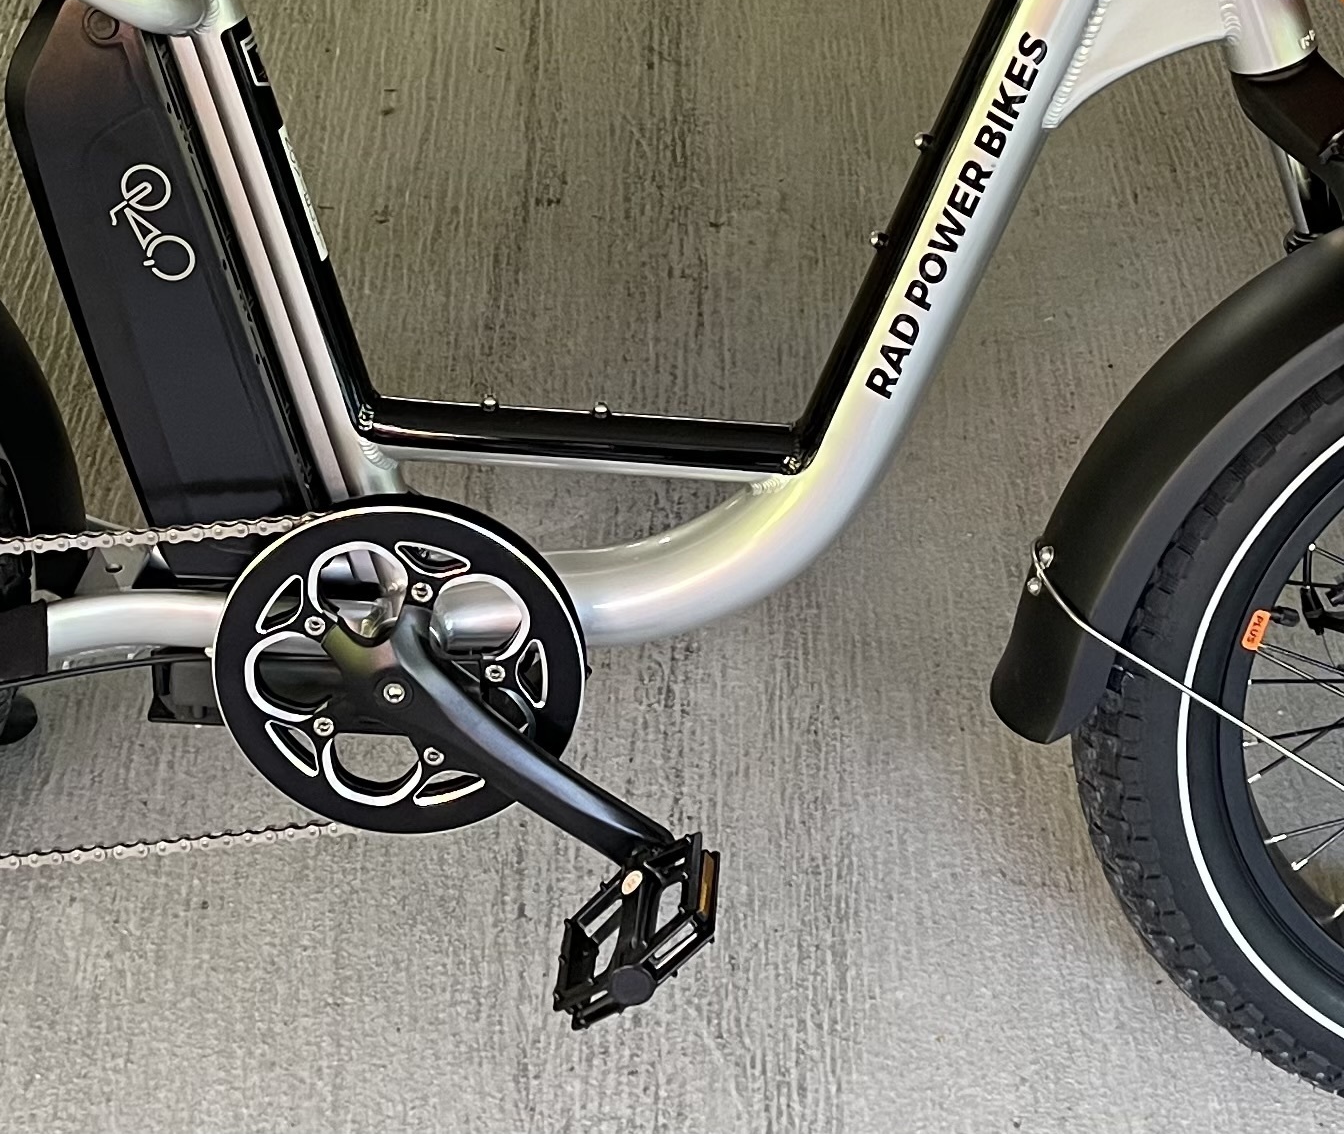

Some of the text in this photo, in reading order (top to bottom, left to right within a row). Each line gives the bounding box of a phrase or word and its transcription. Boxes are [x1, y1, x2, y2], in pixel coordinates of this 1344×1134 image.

[865, 31, 1048, 399] RAD POWER BIKES
[1246, 614, 1265, 644] PLUS
